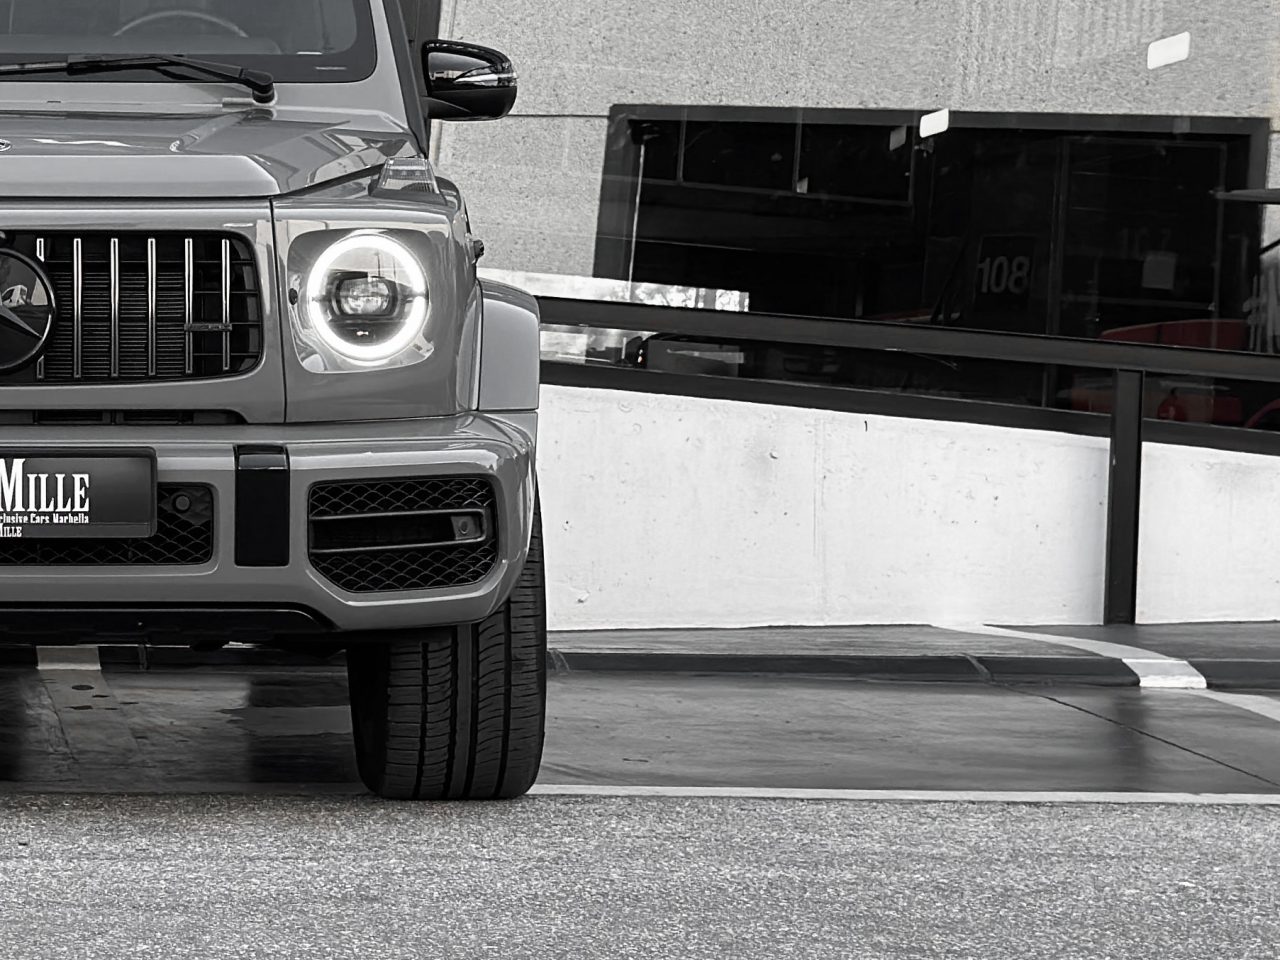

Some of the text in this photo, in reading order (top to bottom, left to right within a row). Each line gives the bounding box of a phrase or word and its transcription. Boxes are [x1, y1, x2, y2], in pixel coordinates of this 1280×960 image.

[977, 255, 1030, 294] 108
[30, 513, 50, 524] Cars
[53, 513, 89, 524] Marbella
